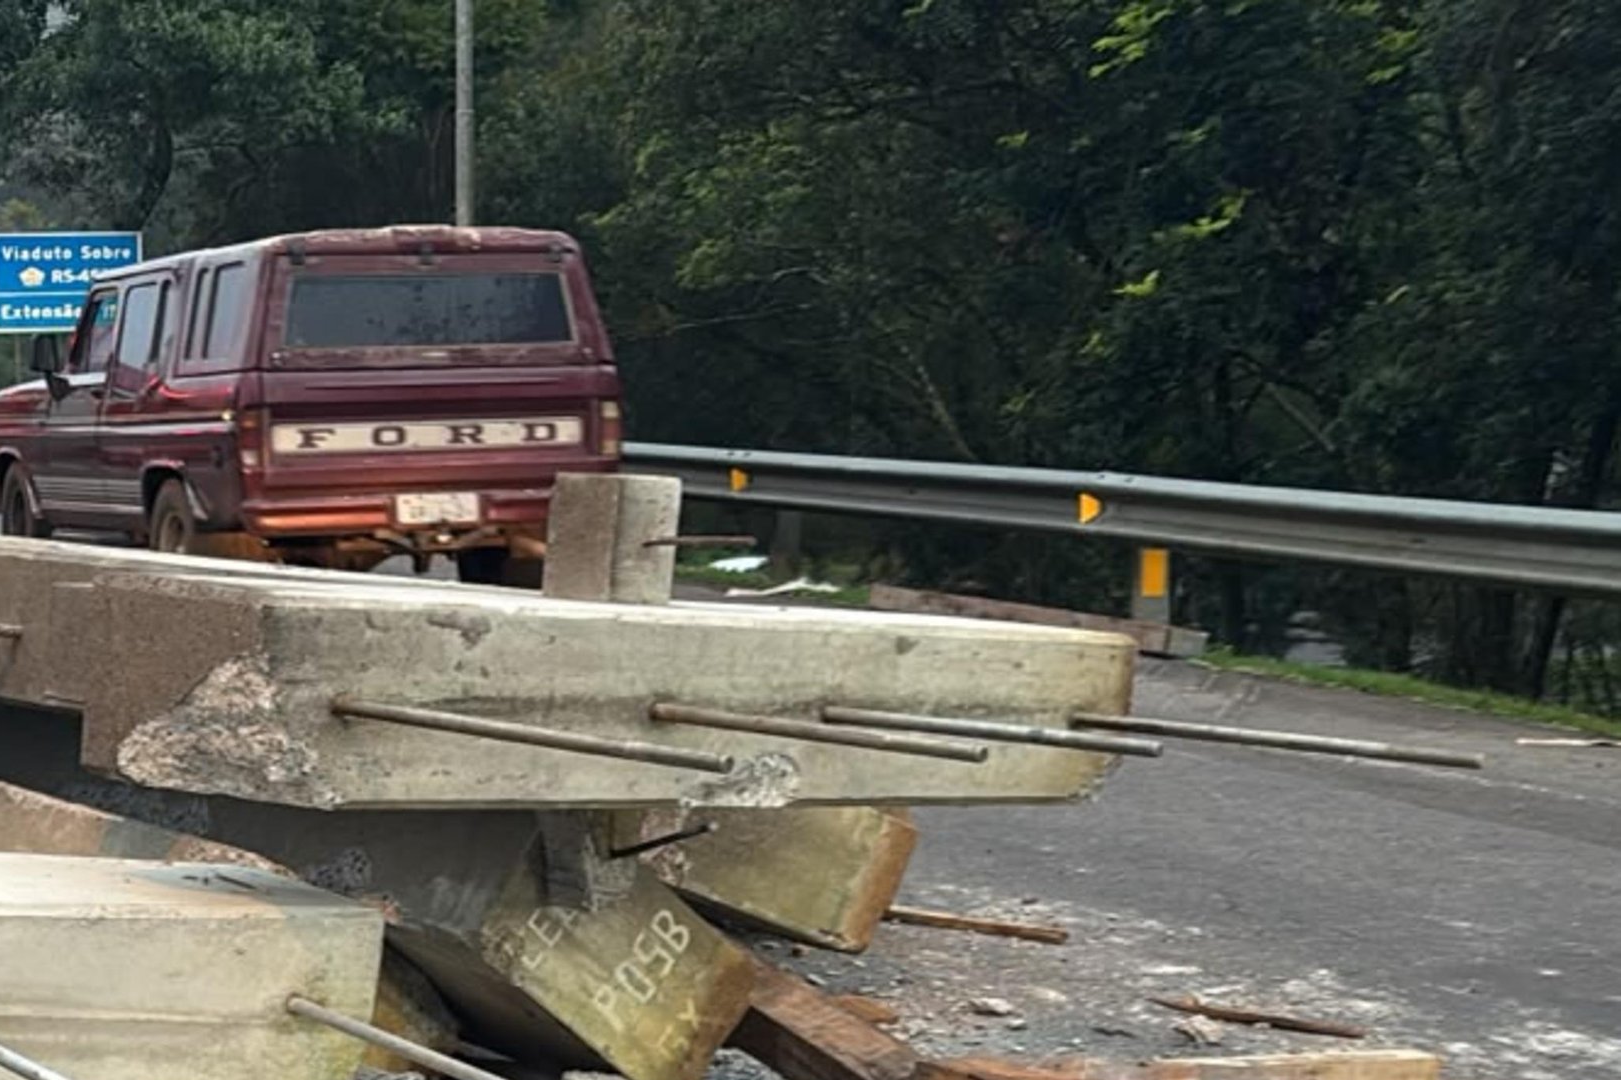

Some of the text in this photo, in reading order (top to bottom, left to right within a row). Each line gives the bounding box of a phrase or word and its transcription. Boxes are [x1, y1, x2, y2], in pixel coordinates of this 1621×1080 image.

[1, 245, 131, 261] Viaduto Sobre
[296, 422, 558, 449] FORD
